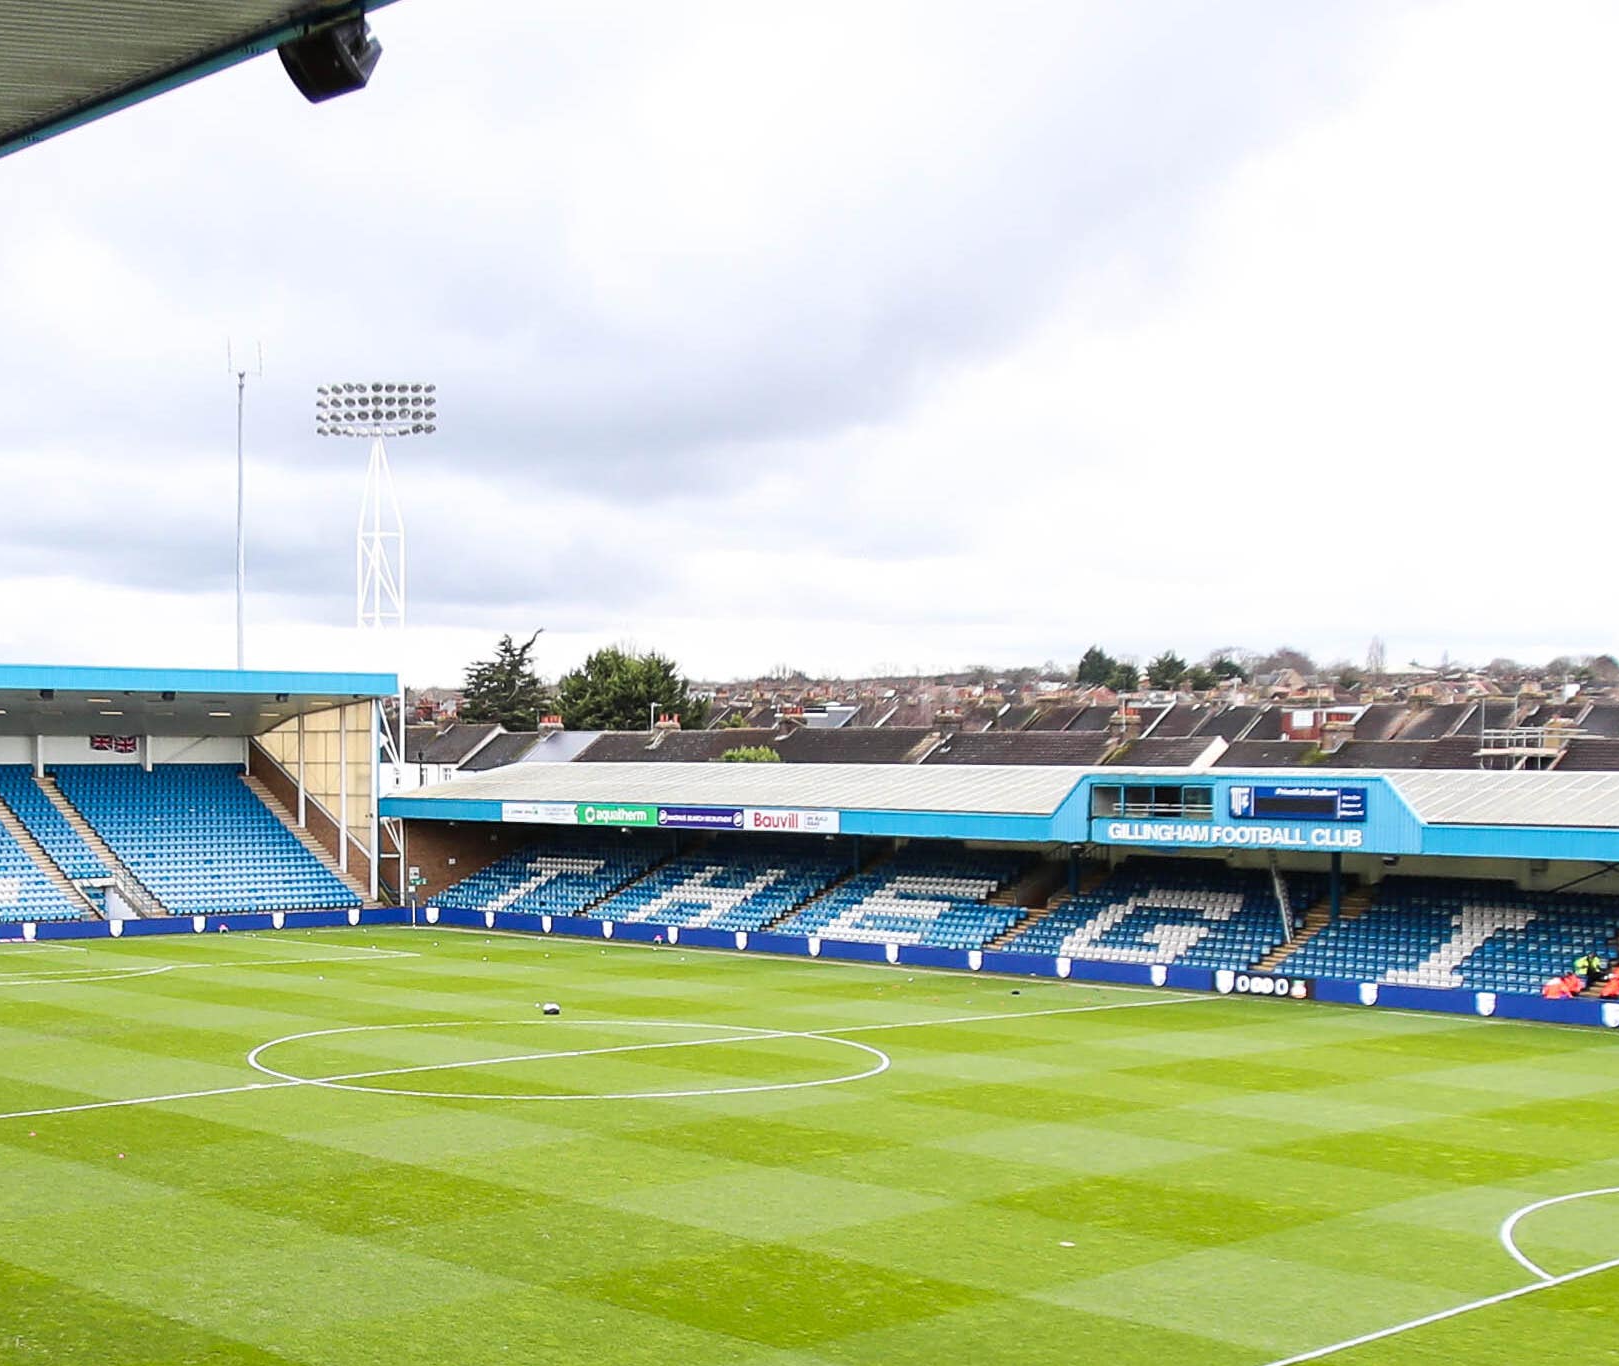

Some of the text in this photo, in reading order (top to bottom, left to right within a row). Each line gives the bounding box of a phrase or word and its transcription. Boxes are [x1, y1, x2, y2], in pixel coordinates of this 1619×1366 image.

[596, 808, 647, 824] aquatherm
[753, 812, 798, 829] Bauvill
[1107, 822, 1363, 846] GILLINGHAM FOOTBALL CLUB
